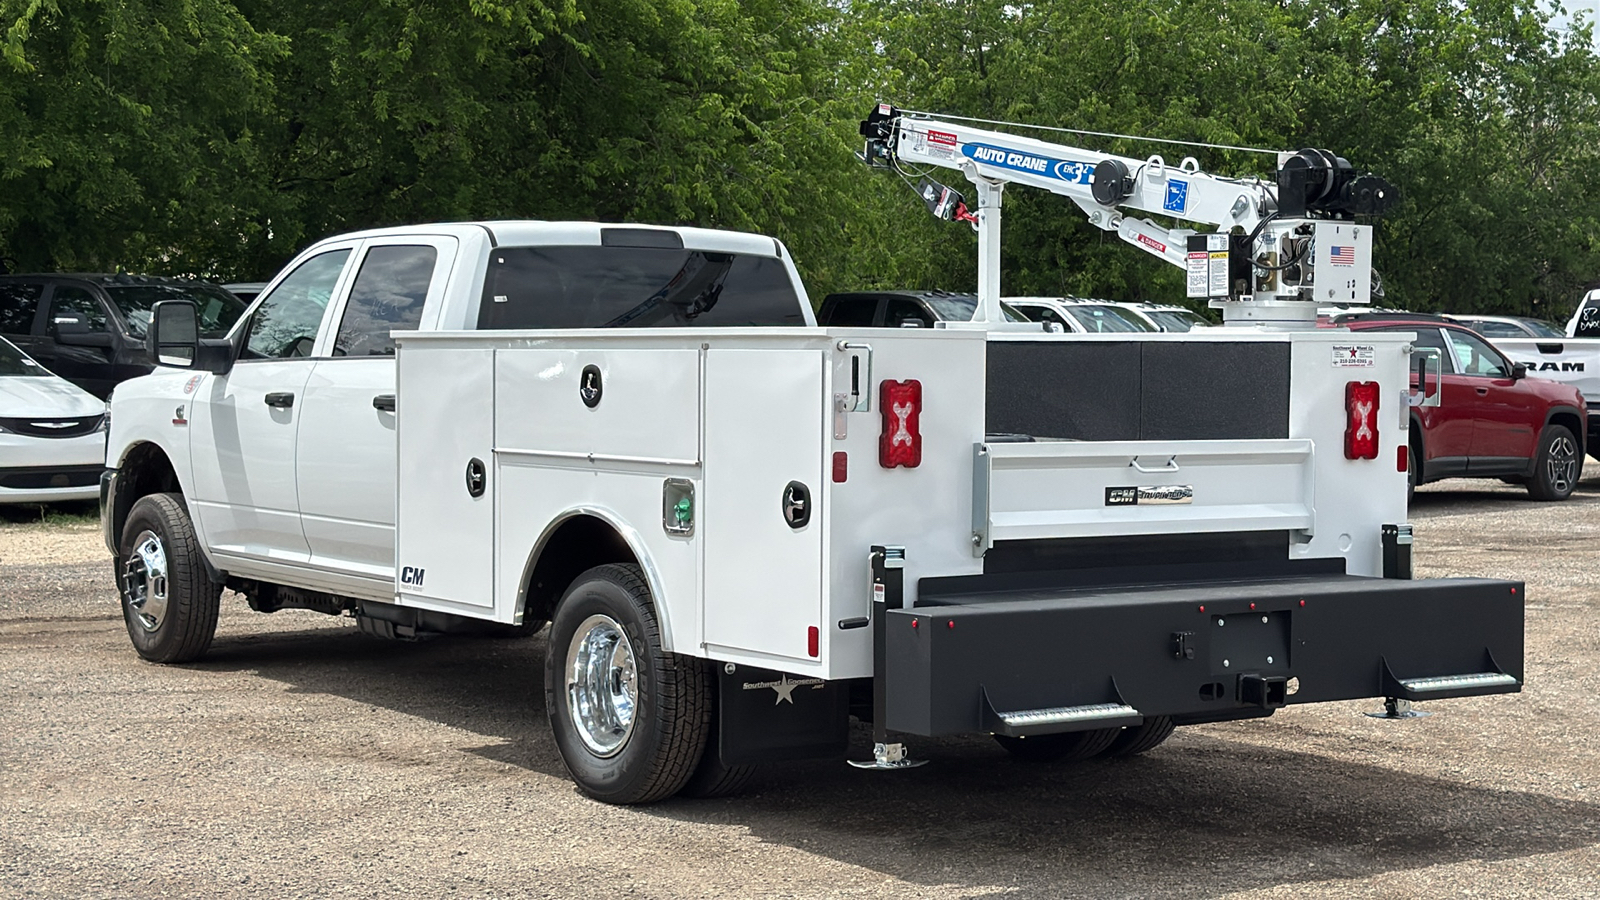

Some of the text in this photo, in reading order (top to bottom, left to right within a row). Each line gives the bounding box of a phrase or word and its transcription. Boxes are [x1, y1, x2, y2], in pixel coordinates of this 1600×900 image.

[973, 147, 1005, 164] AUTO
[1007, 153, 1048, 172] CRANE
[1145, 239, 1164, 251] DANGER
[1109, 490, 1136, 502] CM
[401, 566, 425, 586] CM
[742, 680, 782, 690] Southwest
